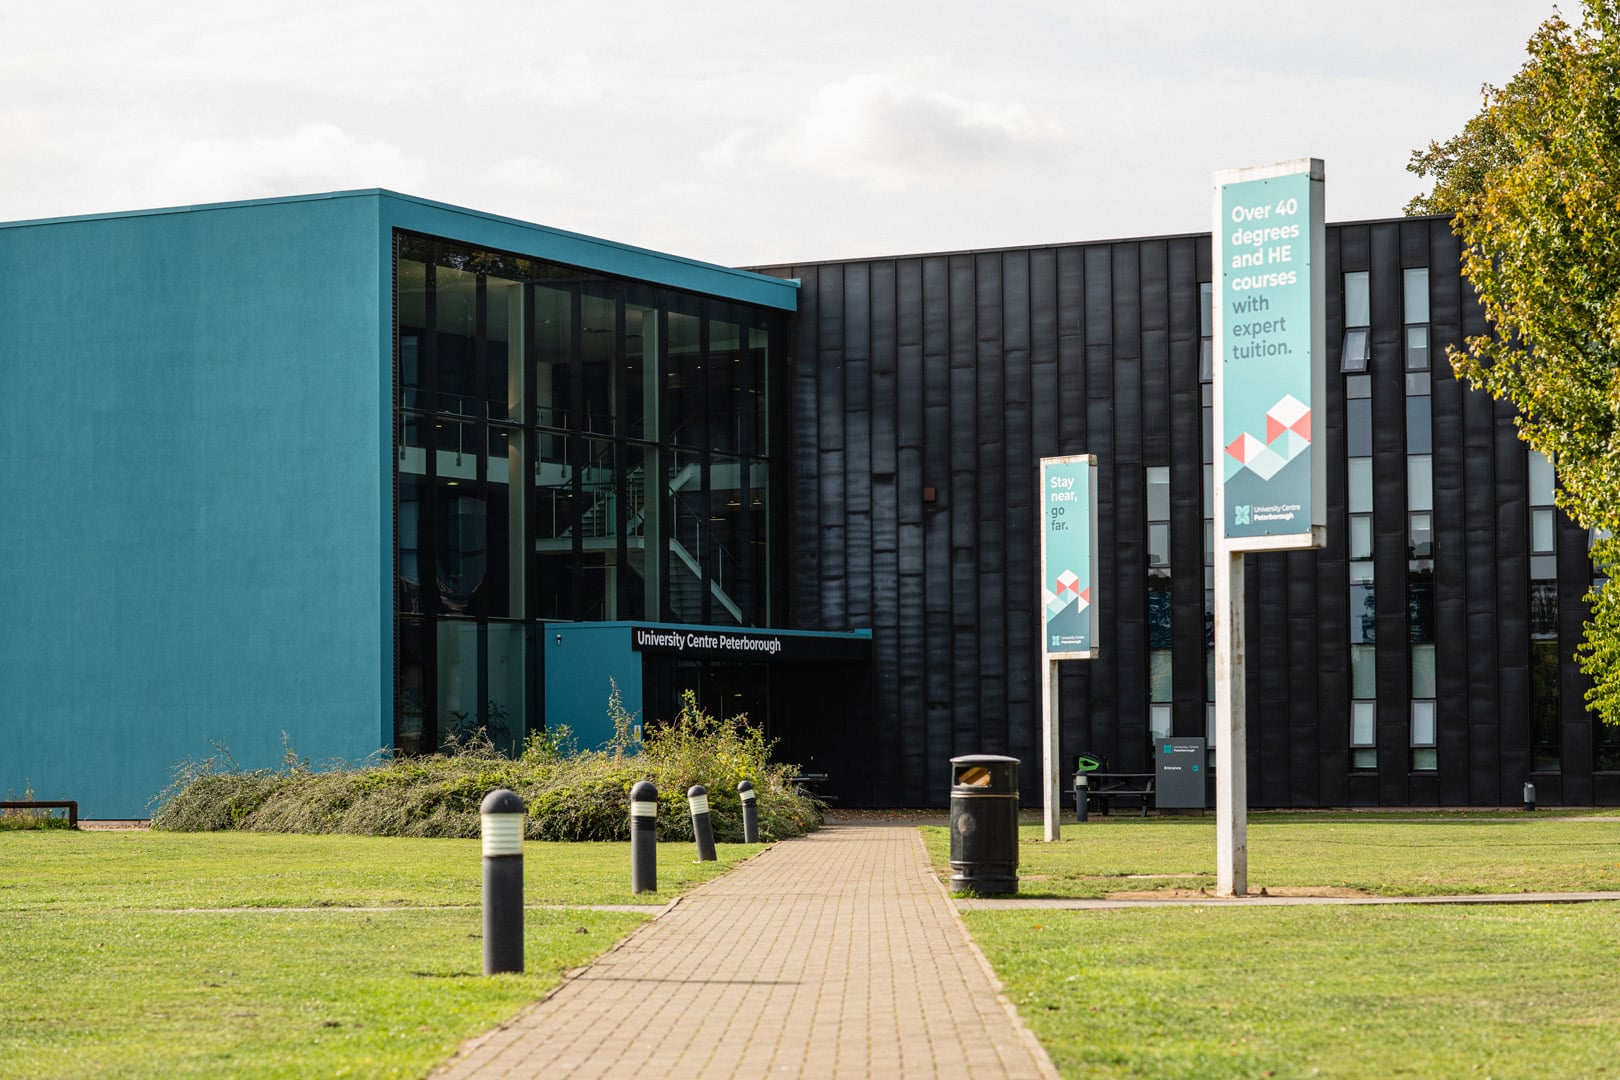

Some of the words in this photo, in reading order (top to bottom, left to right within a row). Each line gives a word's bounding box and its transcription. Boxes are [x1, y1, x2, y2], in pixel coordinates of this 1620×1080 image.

[1231, 205, 1271, 222] Over
[1275, 198, 1297, 216] 40
[1231, 224, 1300, 247] degrees
[1231, 248, 1264, 268] and
[1268, 245, 1292, 264] HE
[1231, 270, 1297, 291] courses
[1232, 295, 1269, 314] with
[1232, 317, 1286, 338] expert
[1232, 339, 1293, 360] tuition.
[1050, 477, 1074, 489] Stay
[1051, 491, 1078, 503] near,
[1051, 506, 1065, 519] go
[1253, 505, 1281, 513] University
[1253, 512, 1294, 520] Peterborough
[1051, 520, 1069, 531] far.
[637, 630, 685, 650] University
[686, 633, 718, 649] Centre
[719, 635, 781, 654] Peterborough
